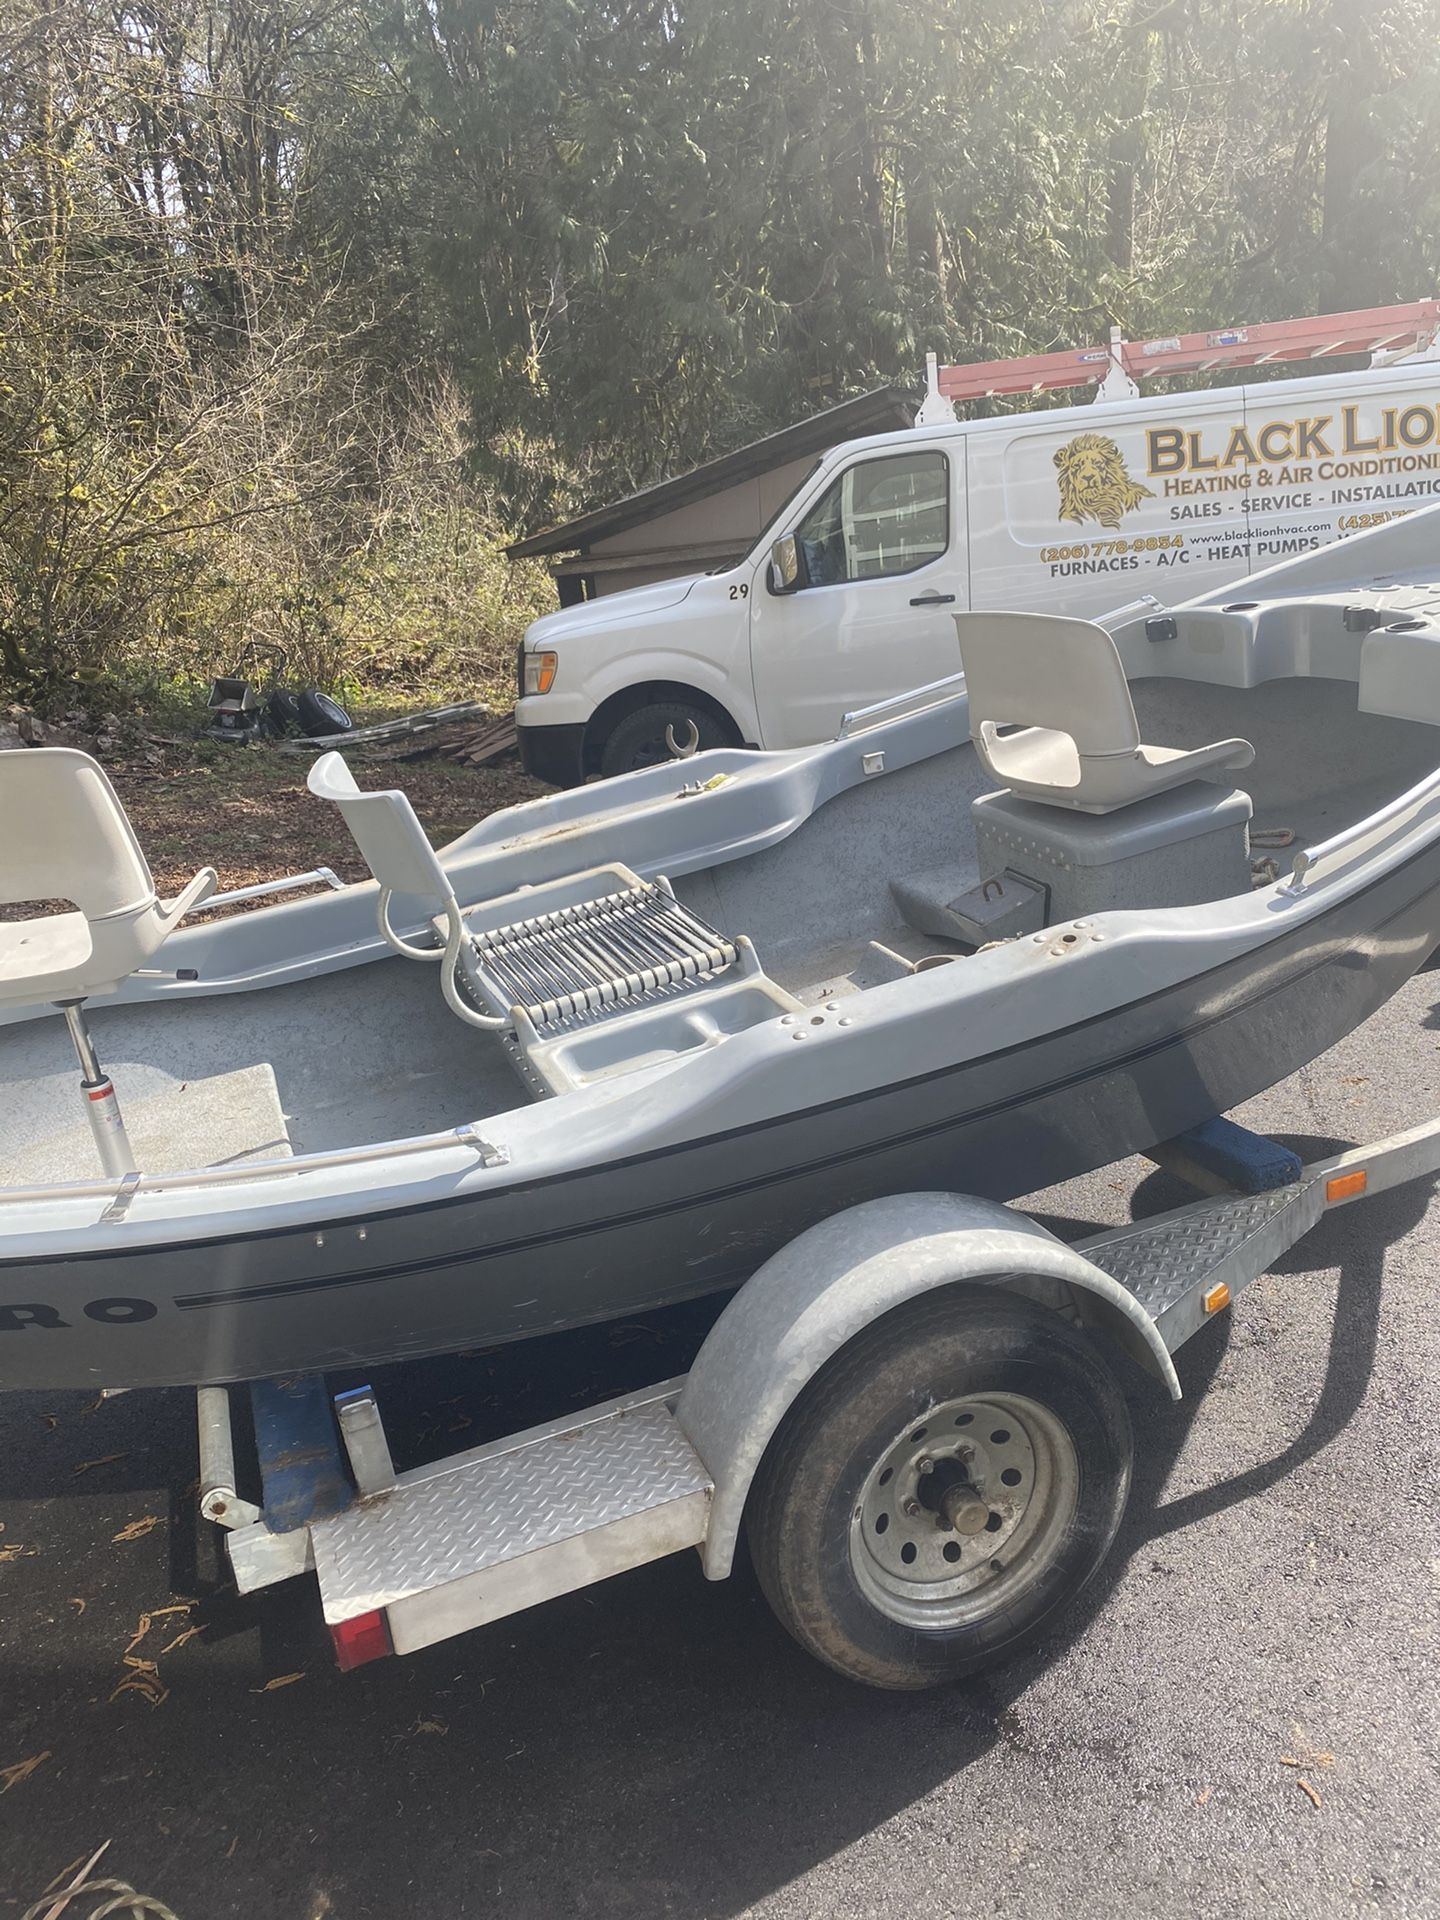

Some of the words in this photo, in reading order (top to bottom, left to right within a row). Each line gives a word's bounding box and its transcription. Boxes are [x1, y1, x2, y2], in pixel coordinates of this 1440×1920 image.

[1144, 415, 1335, 477] BLACK
[1341, 403, 1440, 456] LIO
[1164, 473, 1252, 498] HEATING
[1257, 468, 1273, 487] &
[1276, 466, 1314, 486] AIR
[1170, 502, 1222, 520] SALES
[1240, 493, 1312, 514] SERVICE
[1190, 522, 1332, 545] www.blacklionhvac.com
[1051, 555, 1139, 577] FURNACES
[1156, 550, 1190, 567] A/C
[1208, 544, 1252, 561] HEAT
[1257, 536, 1320, 556] PUMPS
[729, 584, 749, 600] 29
